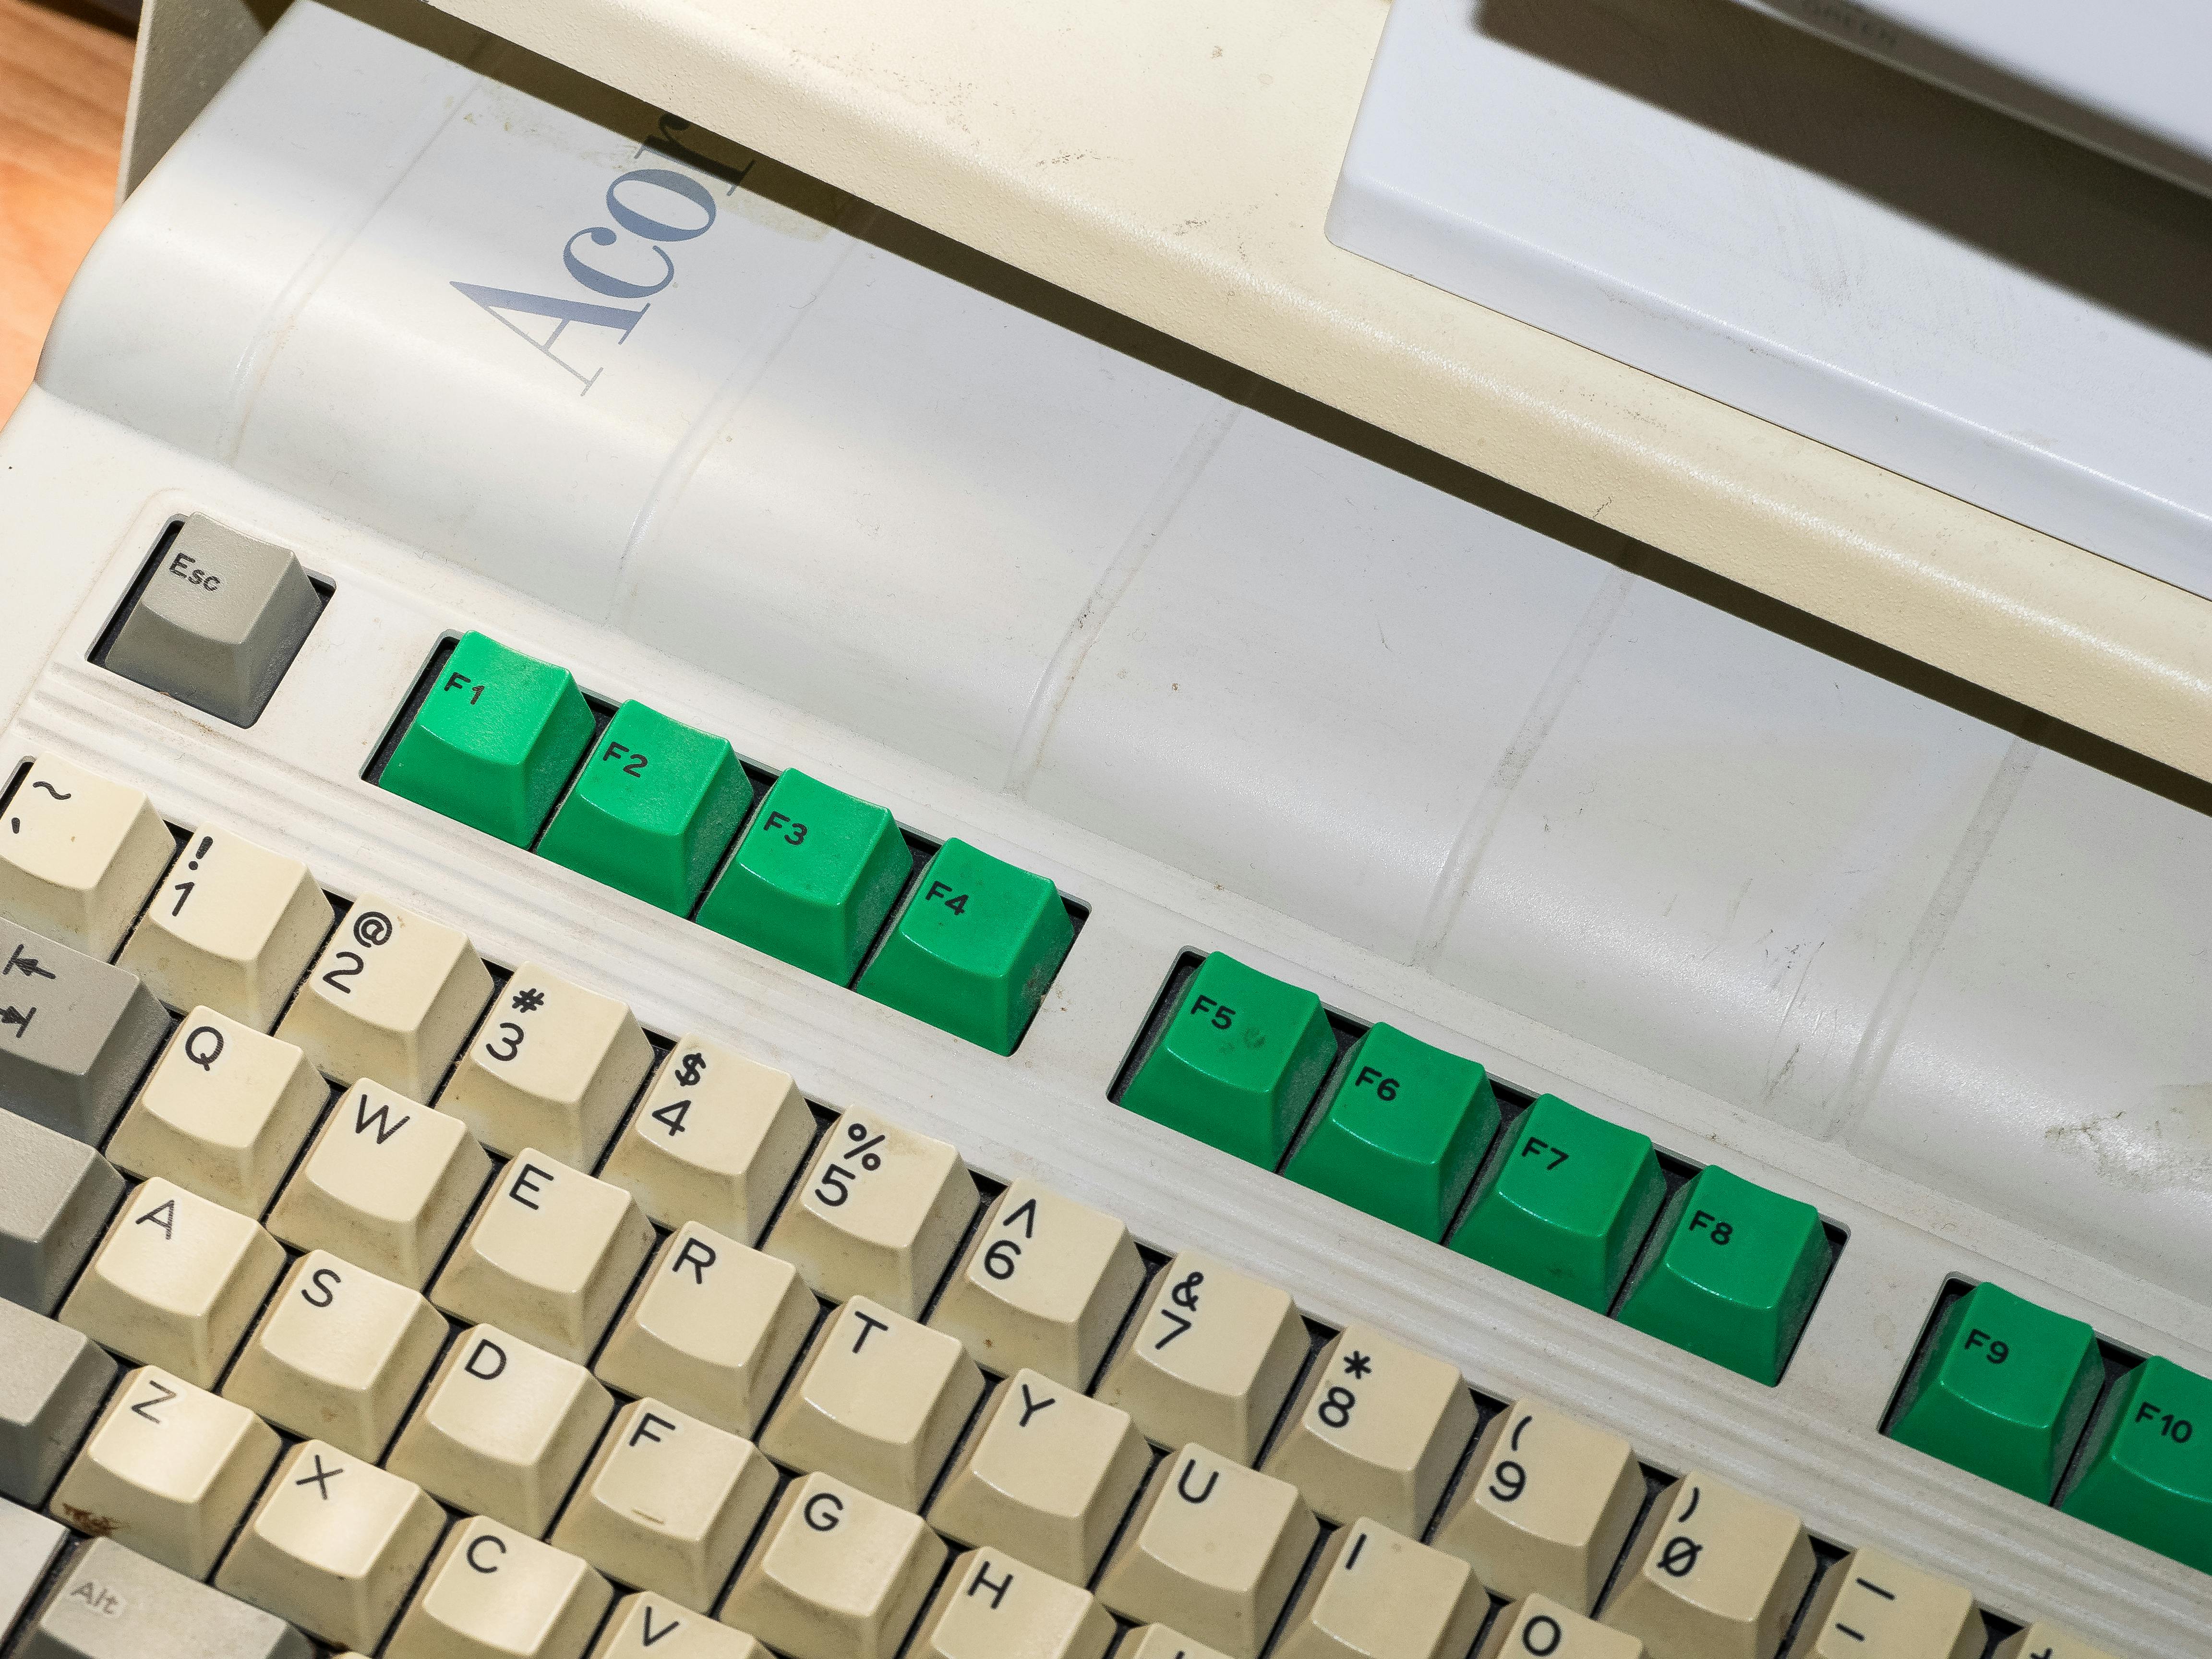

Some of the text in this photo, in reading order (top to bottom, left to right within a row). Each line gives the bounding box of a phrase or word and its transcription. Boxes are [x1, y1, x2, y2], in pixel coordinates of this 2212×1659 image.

[168, 552, 221, 592] Esc
[443, 671, 485, 706] F1
[602, 741, 649, 778] F2
[763, 810, 808, 846] F3
[188, 836, 214, 871] !
[171, 881, 195, 917] 1
[925, 880, 969, 916] F4
[352, 911, 393, 949] @
[322, 950, 365, 994] 2
[511, 987, 545, 1014] #
[1190, 994, 1237, 1031] F5
[184, 1025, 225, 1072] Q
[485, 1022, 525, 1062] 3
[674, 1052, 707, 1087] $
[1354, 1065, 1401, 1102] F6
[355, 1093, 410, 1145] W
[651, 1099, 692, 1137] 4
[843, 1122, 886, 1172] %
[1521, 1136, 1570, 1171] F7
[509, 1163, 554, 1210] E
[815, 1163, 856, 1207] 5
[134, 1199, 175, 1240] A
[1688, 1209, 1733, 1246] F8
[672, 1237, 717, 1285] R
[984, 1239, 1022, 1280] 6
[301, 1268, 342, 1308] S
[1171, 1271, 1204, 1312] &
[852, 1310, 889, 1354] T
[1154, 1309, 1192, 1350] 7
[1963, 1328, 2009, 1365] F9
[464, 1338, 507, 1381] D
[130, 1379, 177, 1424] Z
[1019, 1383, 1056, 1428] Y
[1318, 1386, 1356, 1429] 8
[628, 1412, 676, 1447] F
[1510, 1415, 1533, 1452] (
[2134, 1401, 2193, 1444] F10
[295, 1454, 344, 1501] X
[1178, 1458, 1220, 1504] U
[1488, 1460, 1527, 1503] 9
[803, 1492, 844, 1532] G
[1677, 1486, 1701, 1524] )
[466, 1534, 507, 1575] C
[70, 1581, 118, 1614] Alt
[966, 1560, 1014, 1610] H
[642, 1605, 680, 1647] V
[1521, 1614, 1562, 1658] O
